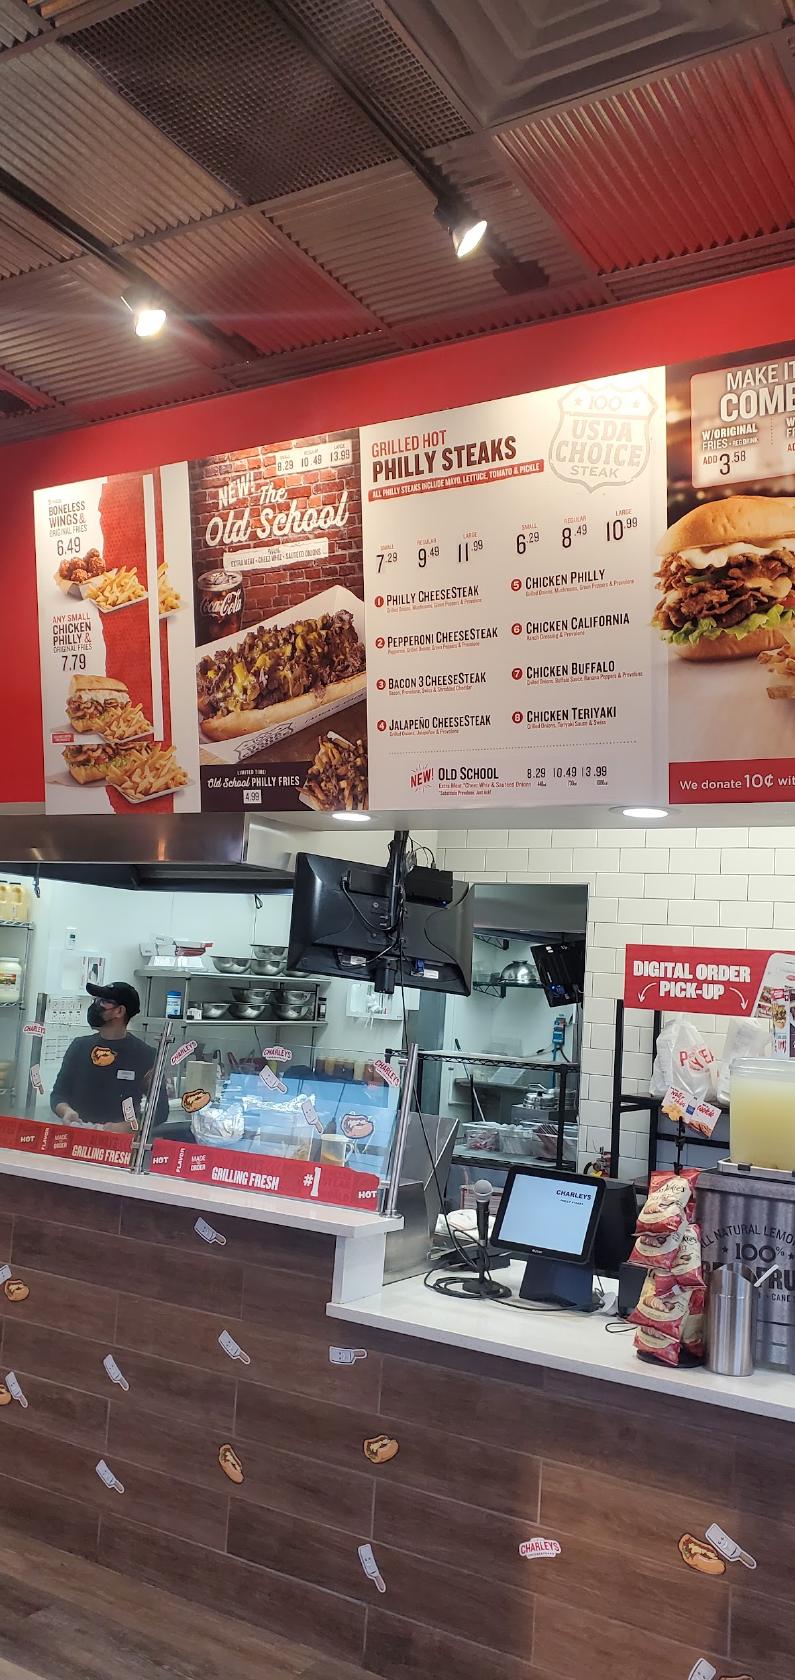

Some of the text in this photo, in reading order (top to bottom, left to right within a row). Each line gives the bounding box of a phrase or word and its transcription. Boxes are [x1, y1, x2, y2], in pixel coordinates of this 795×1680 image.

[726, 364, 779, 391] MAKE
[572, 419, 632, 443] USDA
[701, 423, 759, 441] W/ORIGINAL
[371, 429, 447, 458] GRILLED HOT
[702, 438, 728, 451] FRIES
[373, 435, 518, 483] PHILLY STEAKS
[556, 440, 643, 467] CHOICE
[703, 450, 746, 475] ADD 3.58
[372, 488, 382, 498] ALL
[382, 484, 401, 497] PHILLY
[401, 481, 421, 494] STEAKS
[421, 478, 445, 491] INCLUDE
[489, 466, 513, 480] TOMATO
[513, 465, 519, 475] &
[519, 461, 541, 474] PICKLE
[570, 465, 620, 479] STEAK
[217, 472, 255, 509] NEW!
[48, 500, 86, 517] BONELESS
[48, 512, 86, 528] WINGS &
[205, 490, 350, 546] Old School
[521, 509, 632, 531] SMALL REGULAR LARGE
[516, 517, 638, 554] 6.29 8.49 10.99
[57, 536, 81, 557] 6.49
[376, 540, 483, 573] 7.29 9.49 11.99
[525, 572, 568, 591] CHICKEN
[570, 568, 606, 585] PHILLY
[386, 592, 416, 607] PHILLY
[52, 611, 91, 624] ANY SMALL
[525, 619, 569, 635] CHICKEN
[571, 612, 631, 631] CALIFORNIA
[52, 620, 92, 636] CHICKEN
[53, 631, 91, 647] PHILLY &
[77, 642, 92, 652] FRIES
[387, 633, 434, 648] PEPPERONI
[61, 653, 86, 671] 7.79
[525, 663, 569, 679] CHICKEN
[571, 659, 616, 676] BUFFALO
[388, 678, 417, 690] BACON
[418, 675, 424, 688] 3
[526, 709, 569, 723] CHICKEN
[571, 705, 617, 721] TERIYAKI
[389, 716, 430, 731] JALAPEÑO
[207, 776, 300, 788] Old School PHILLY FRIES
[410, 765, 607, 789] NEW! OLD SCHOOL 8.29 10.49 13.99
[679, 779, 698, 791] We
[701, 779, 742, 790] donate
[744, 773, 774, 789] 10¢
[245, 791, 261, 801] 4.99
[633, 959, 751, 983] DIGITAL ORDER
[659, 980, 725, 1000] PICK-UP
[263, 1048, 292, 1059] CHARLEYS
[374, 1059, 401, 1086] CHARLEYS
[20, 1135, 36, 1143] HOT
[72, 1144, 131, 1165] GRILLING FRESH
[153, 1156, 169, 1164] HOT
[211, 1166, 280, 1191] GRILLING FRESH
[303, 1166, 322, 1197] #1
[358, 1190, 378, 1199] HOT
[556, 1189, 592, 1201] CHARLEYS
[713, 1223, 760, 1241] NATURAL
[735, 1242, 785, 1264] 100%
[771, 1293, 791, 1303] CANE
[520, 1541, 559, 1555] CHARLEYS
